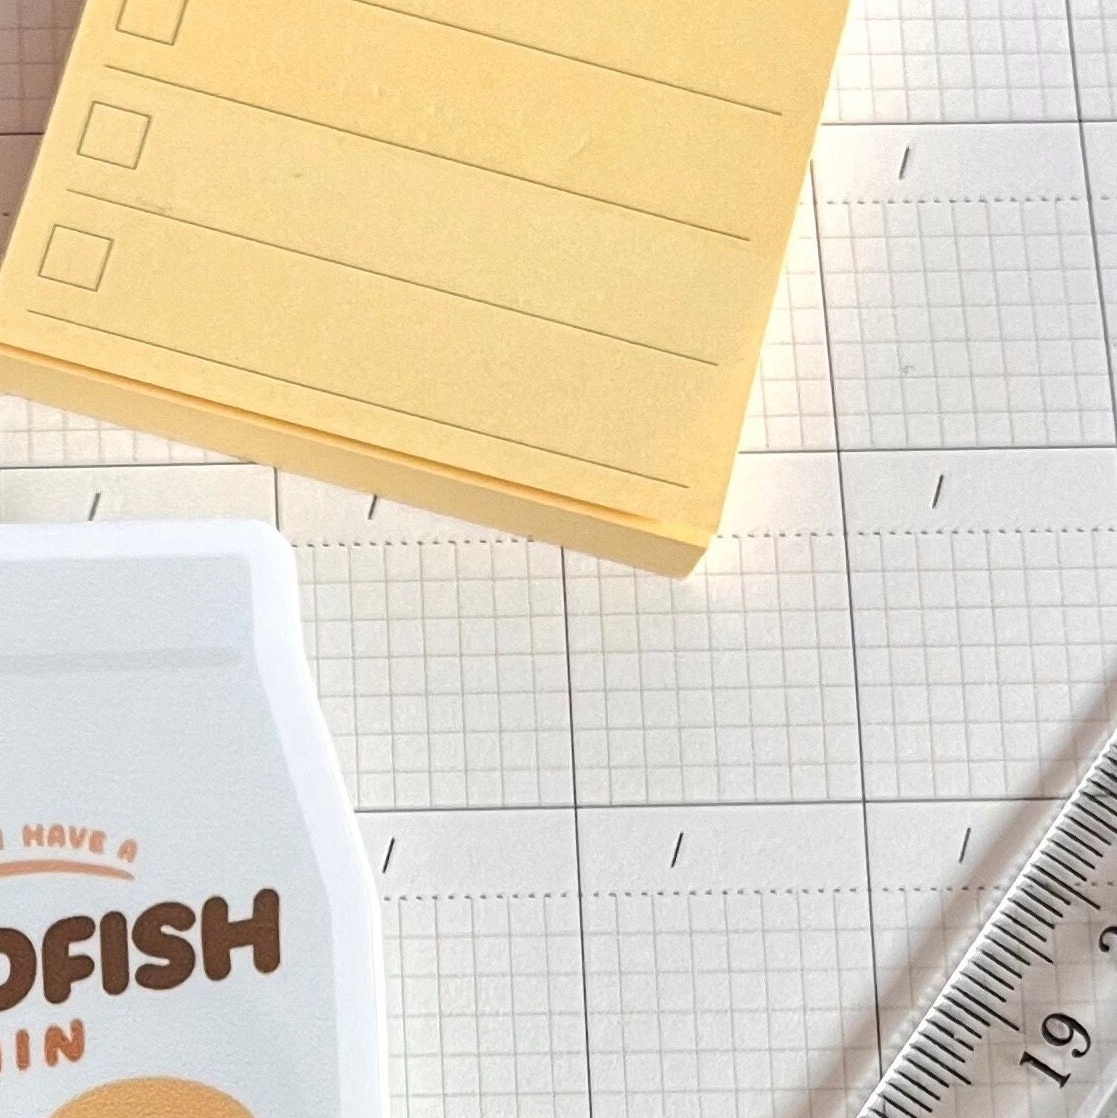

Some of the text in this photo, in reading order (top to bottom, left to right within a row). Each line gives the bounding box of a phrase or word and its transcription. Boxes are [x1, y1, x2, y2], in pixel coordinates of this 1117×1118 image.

[23, 823, 108, 857] HAVE
[116, 839, 139, 863] A
[1019, 1013, 1091, 1088] 19
